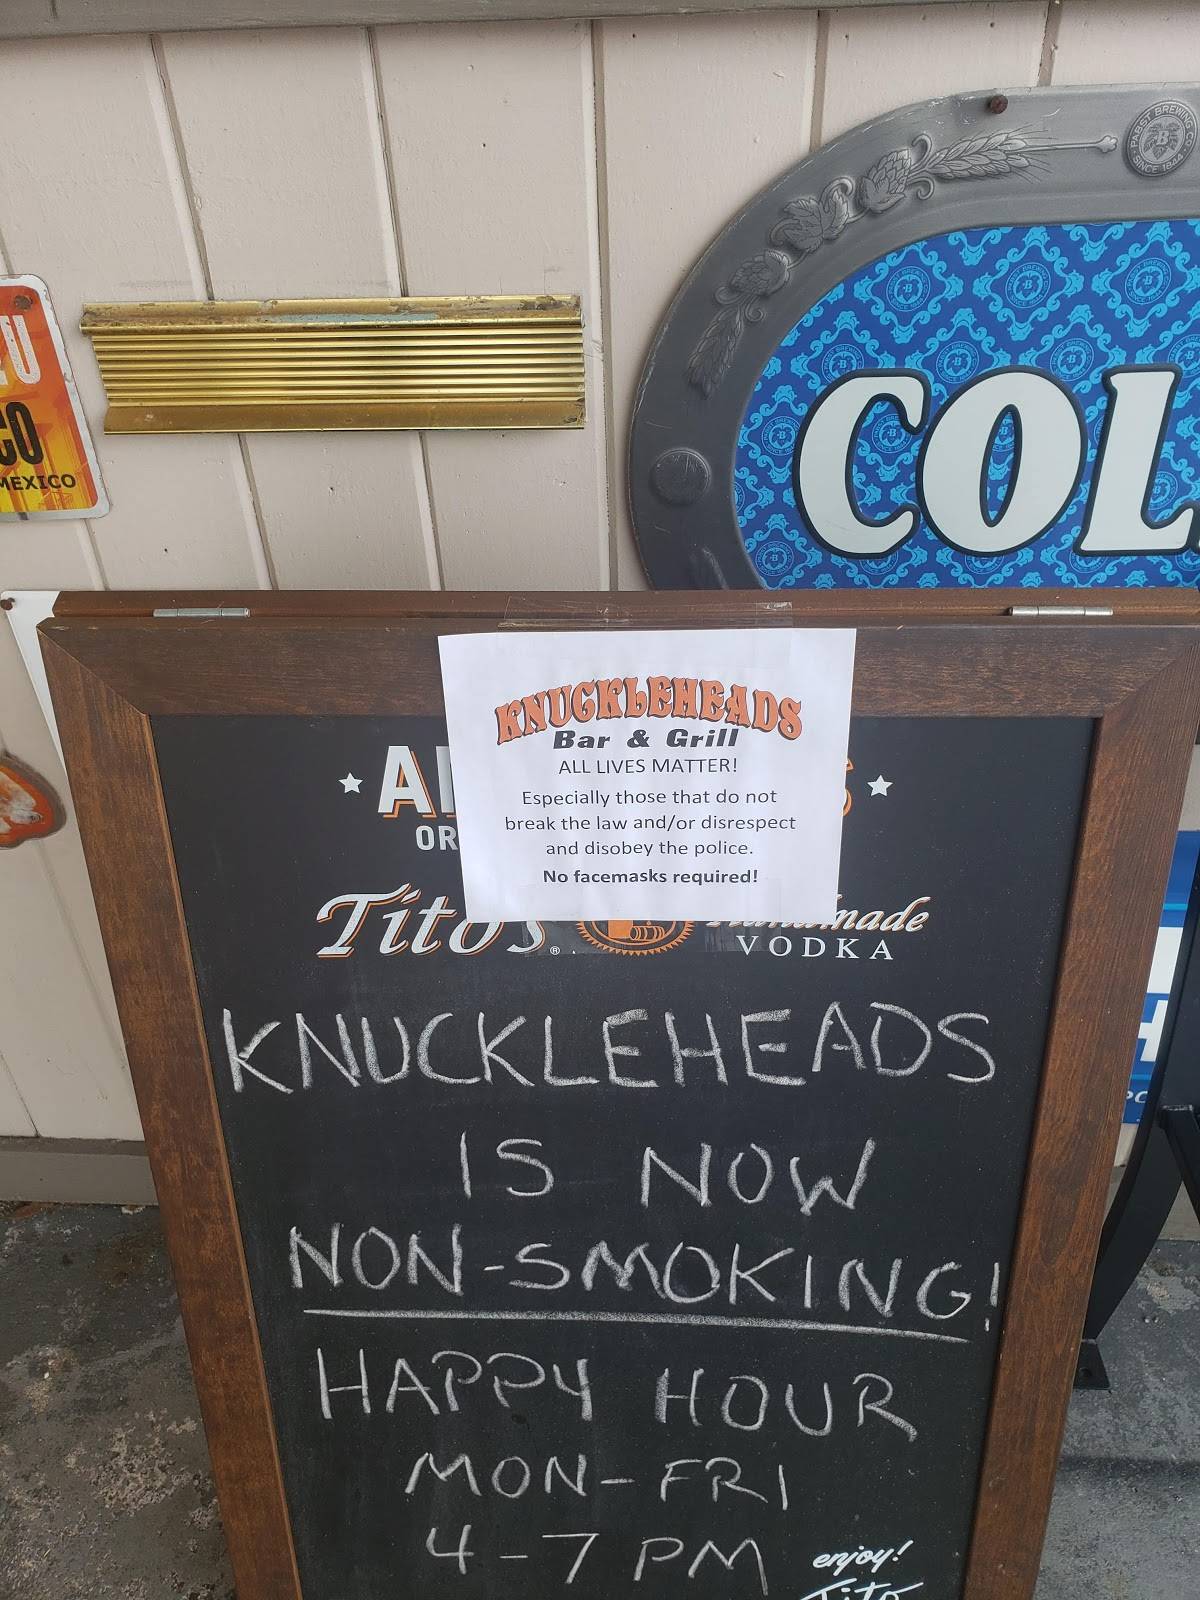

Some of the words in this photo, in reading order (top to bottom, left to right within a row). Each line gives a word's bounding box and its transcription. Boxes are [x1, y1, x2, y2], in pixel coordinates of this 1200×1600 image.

[1130, 112, 1152, 148] PABST
[1154, 105, 1194, 129] BREWING
[1133, 155, 1159, 174] SINCE
[792, 364, 1200, 558] COL
[494, 675, 803, 745] KNUCKLEHEADS
[553, 729, 611, 750] Bar
[626, 729, 651, 748] &
[666, 728, 739, 748] Grill
[558, 759, 591, 775] ALL
[596, 759, 646, 774] LIVES
[651, 758, 738, 774] MATTER!
[522, 789, 610, 808] Especially
[615, 789, 667, 804] those
[672, 789, 710, 804] that
[716, 789, 740, 803] do
[746, 790, 778, 803] not
[505, 816, 556, 831] break
[561, 816, 591, 831] the
[597, 815, 628, 831] law
[633, 814, 696, 832] and/or
[701, 815, 797, 832] disrespect
[546, 841, 579, 855] and
[584, 841, 653, 857] disobey
[659, 841, 688, 855] the
[694, 840, 754, 857] police.
[543, 870, 569, 883] No
[573, 868, 667, 883] facemasks
[673, 869, 758, 886] required!
[736, 935, 894, 960] VODKA
[222, 1001, 997, 1095] KNUCKLEHEADS
[459, 1131, 554, 1198] IS
[641, 1139, 877, 1215] NOW
[316, 1347, 593, 1421] HAPPY
[655, 1367, 917, 1441] HOUR
[632, 1537, 769, 1596] PM
[812, 1539, 914, 1577] enjoy!
